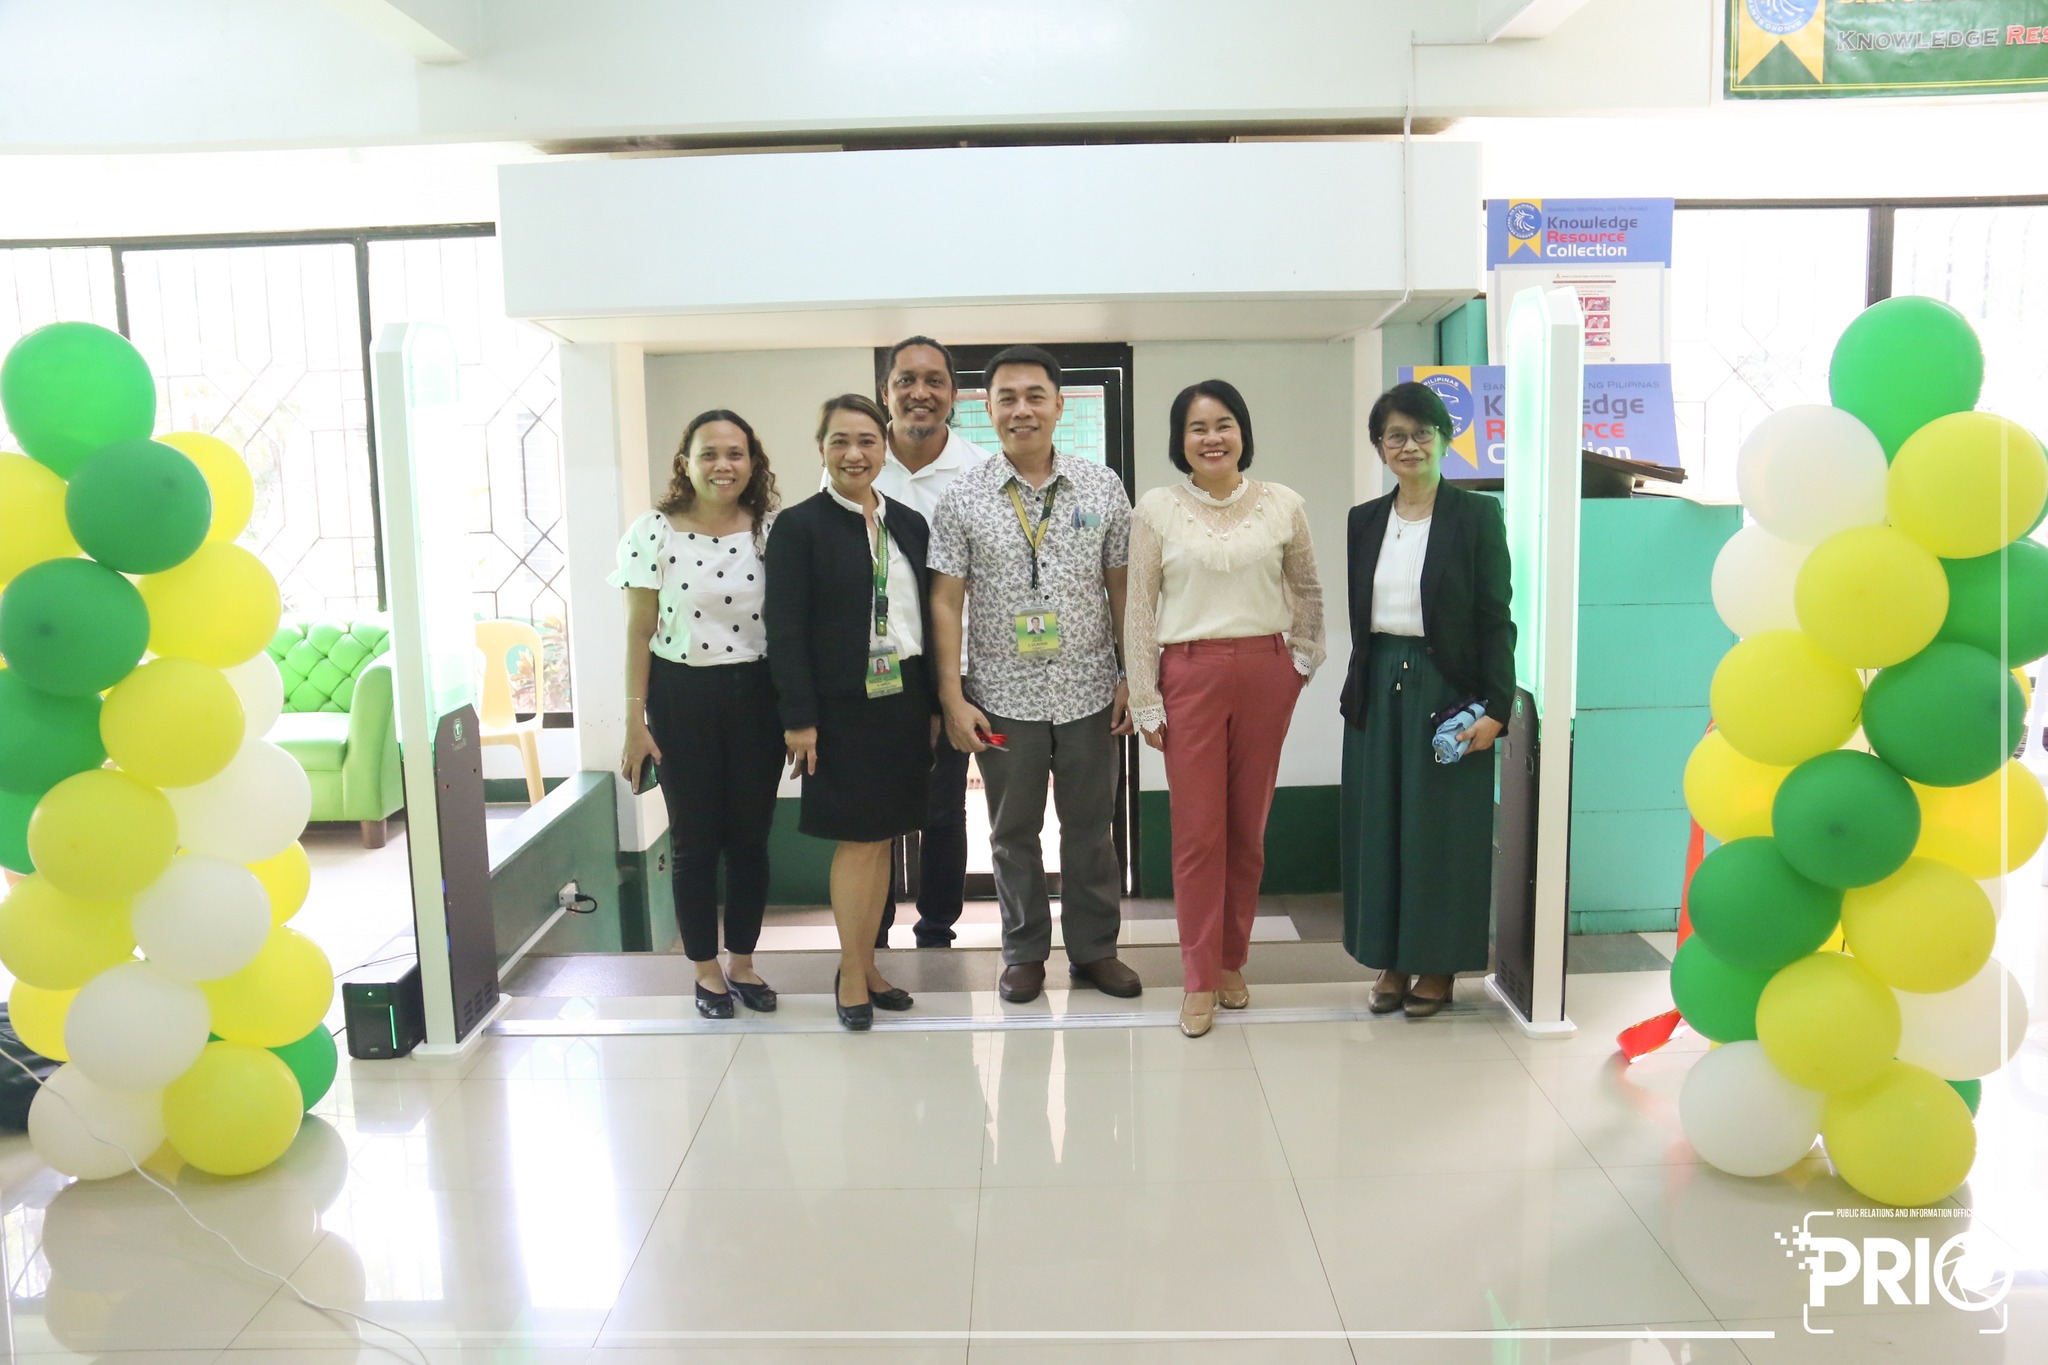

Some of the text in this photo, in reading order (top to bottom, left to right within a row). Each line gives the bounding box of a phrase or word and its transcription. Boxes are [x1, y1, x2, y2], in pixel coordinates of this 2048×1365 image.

[1837, 28, 1999, 51] KNOWLEDGE
[1547, 216, 1638, 231] Knowledge
[1547, 230, 1625, 243] Resource
[1546, 243, 1627, 257] Collection
[1423, 377, 1459, 387] PILIPINAS
[1607, 381, 1660, 389] PILIPINAS
